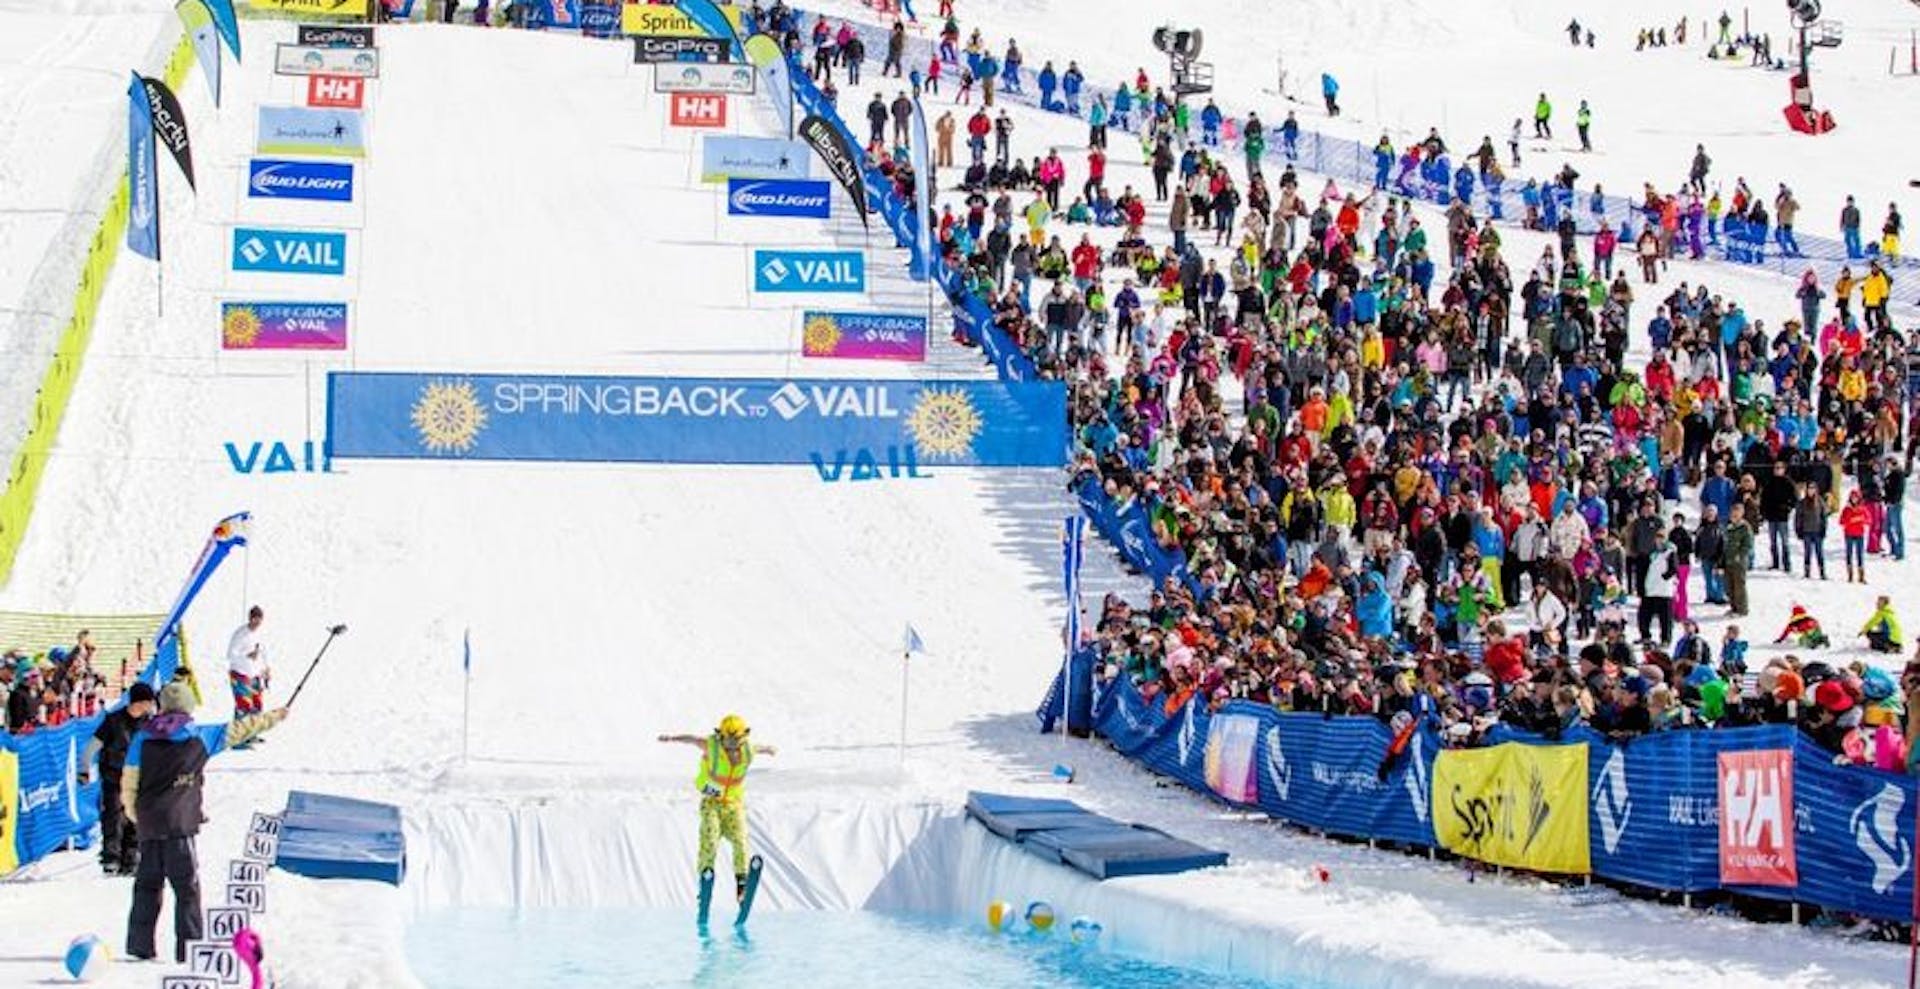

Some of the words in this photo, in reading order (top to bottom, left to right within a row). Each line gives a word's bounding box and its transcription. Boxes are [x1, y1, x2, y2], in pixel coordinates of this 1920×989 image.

[641, 13, 695, 31] Sprint
[643, 39, 721, 53] GoPro
[316, 77, 357, 99] HH
[678, 96, 720, 119] HH
[260, 174, 298, 188] BUD
[297, 176, 349, 190] LIGHT
[738, 193, 776, 205] BUD
[775, 194, 827, 207] LIGHT
[273, 240, 339, 266] VAIL
[793, 260, 859, 283] VAIL
[748, 405, 768, 418] TO
[811, 386, 899, 418] VAIL
[808, 444, 934, 482] VAIL
[1450, 782, 1517, 854] Sprit
[1725, 767, 1784, 848] HH
[254, 816, 278, 835] 20
[249, 836, 271, 856] 30
[234, 864, 260, 882] 40
[234, 888, 260, 909] 50
[214, 913, 243, 937] 60
[199, 951, 233, 978] 70
